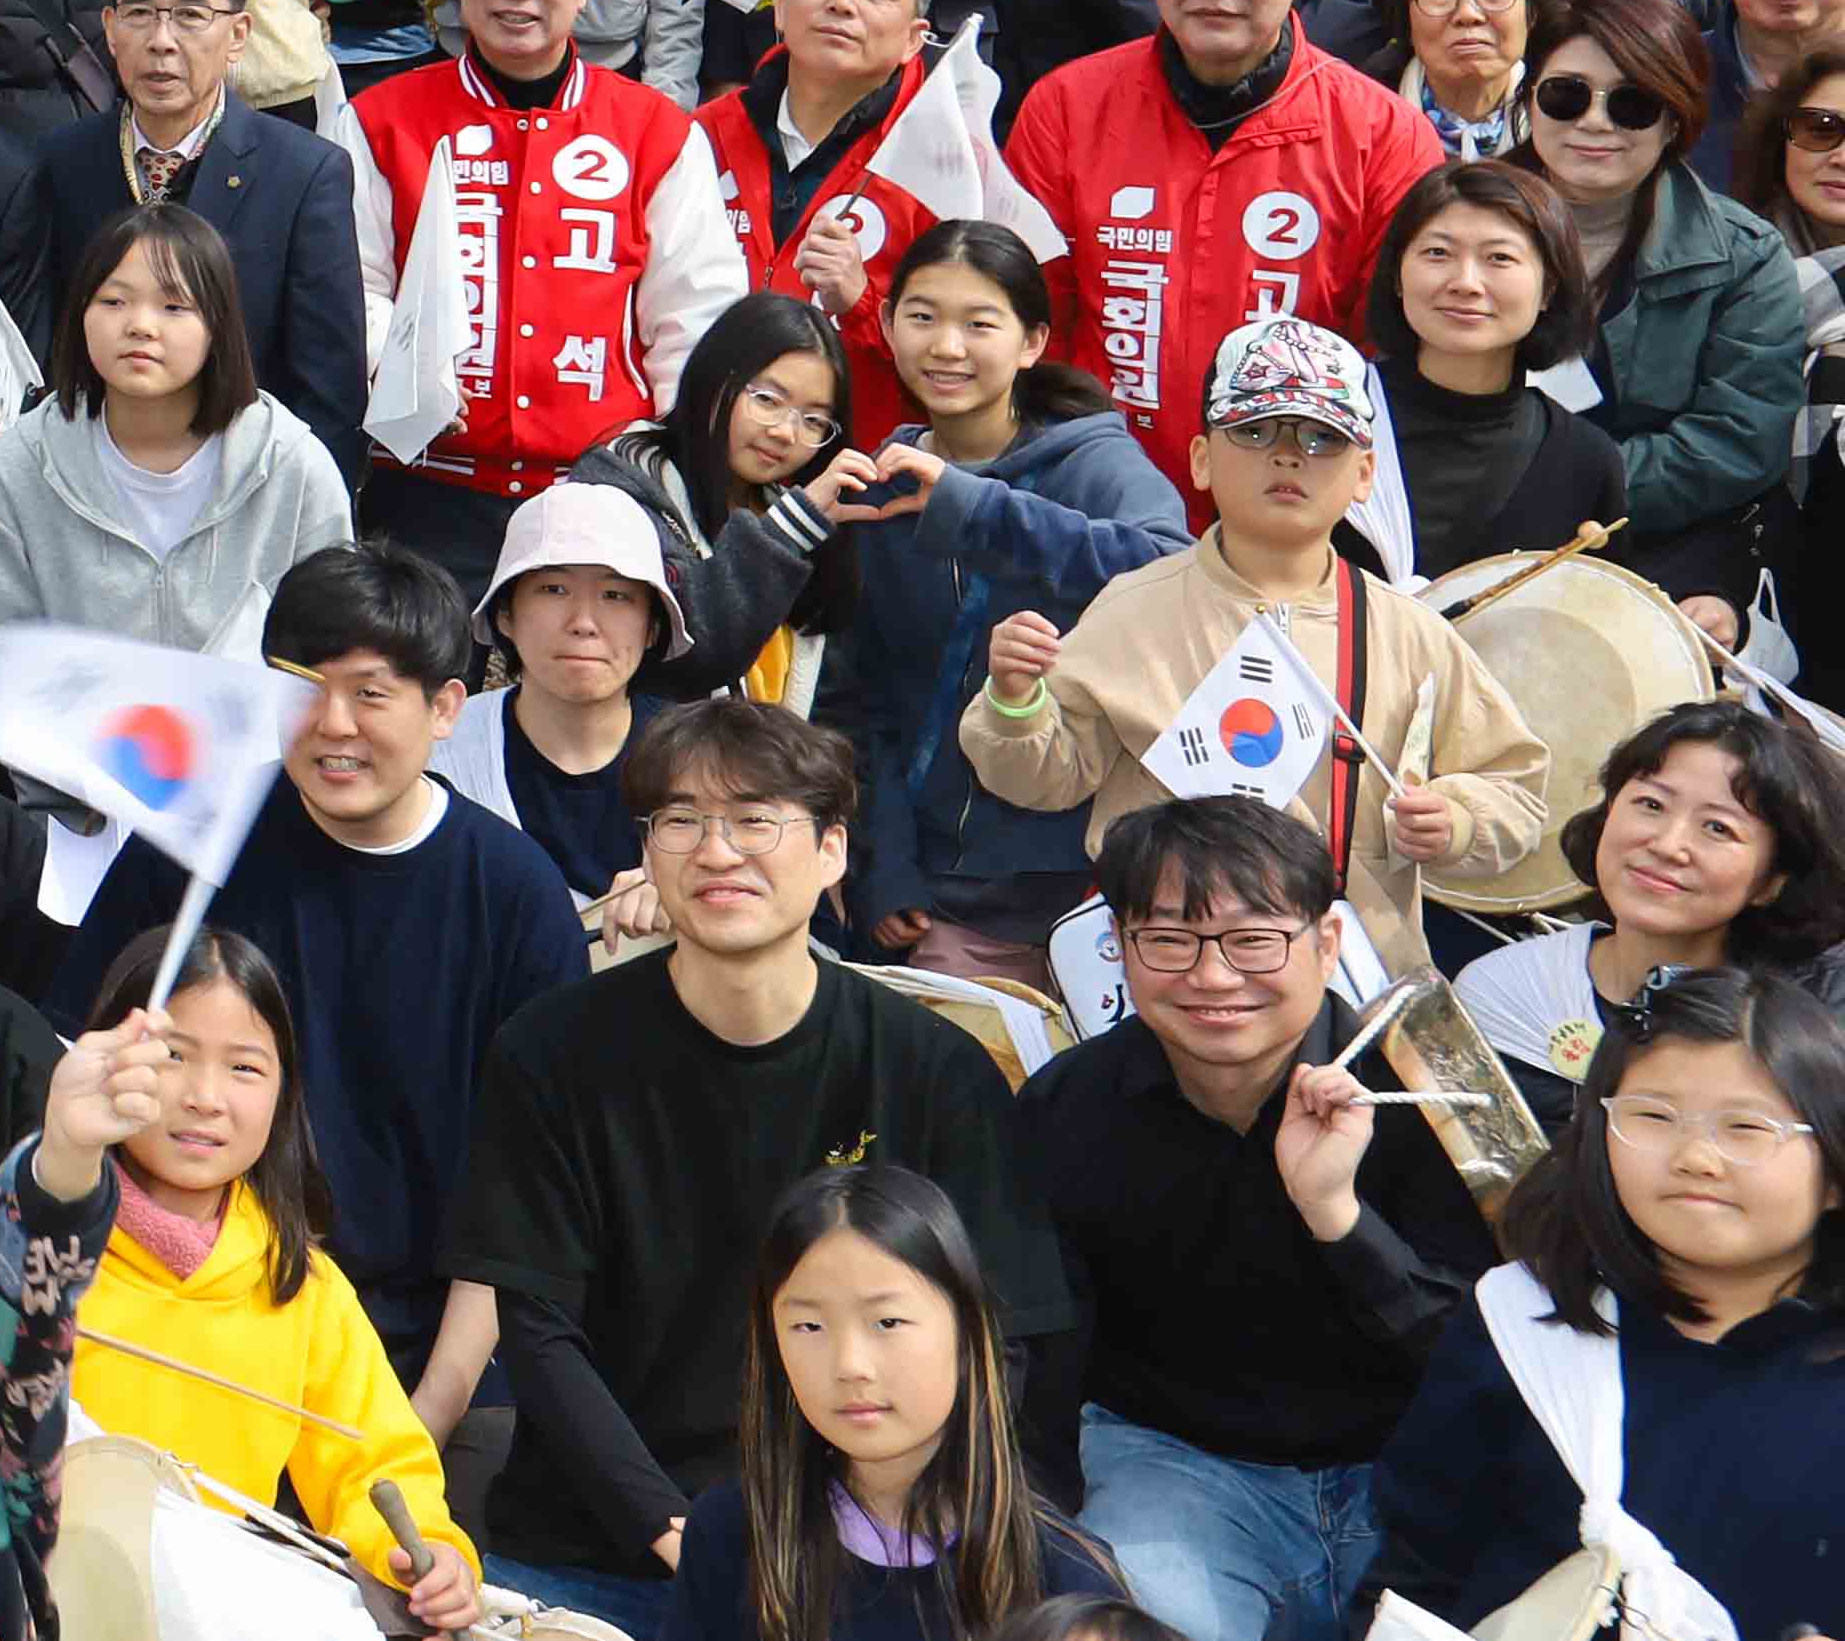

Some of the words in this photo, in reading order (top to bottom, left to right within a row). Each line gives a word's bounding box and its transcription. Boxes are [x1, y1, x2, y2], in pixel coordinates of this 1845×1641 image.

[453, 160, 507, 186] 민의힘
[1096, 225, 1174, 253] 국민의힘
[1245, 269, 1303, 326] 고
[1100, 260, 1170, 410] 국회의원
